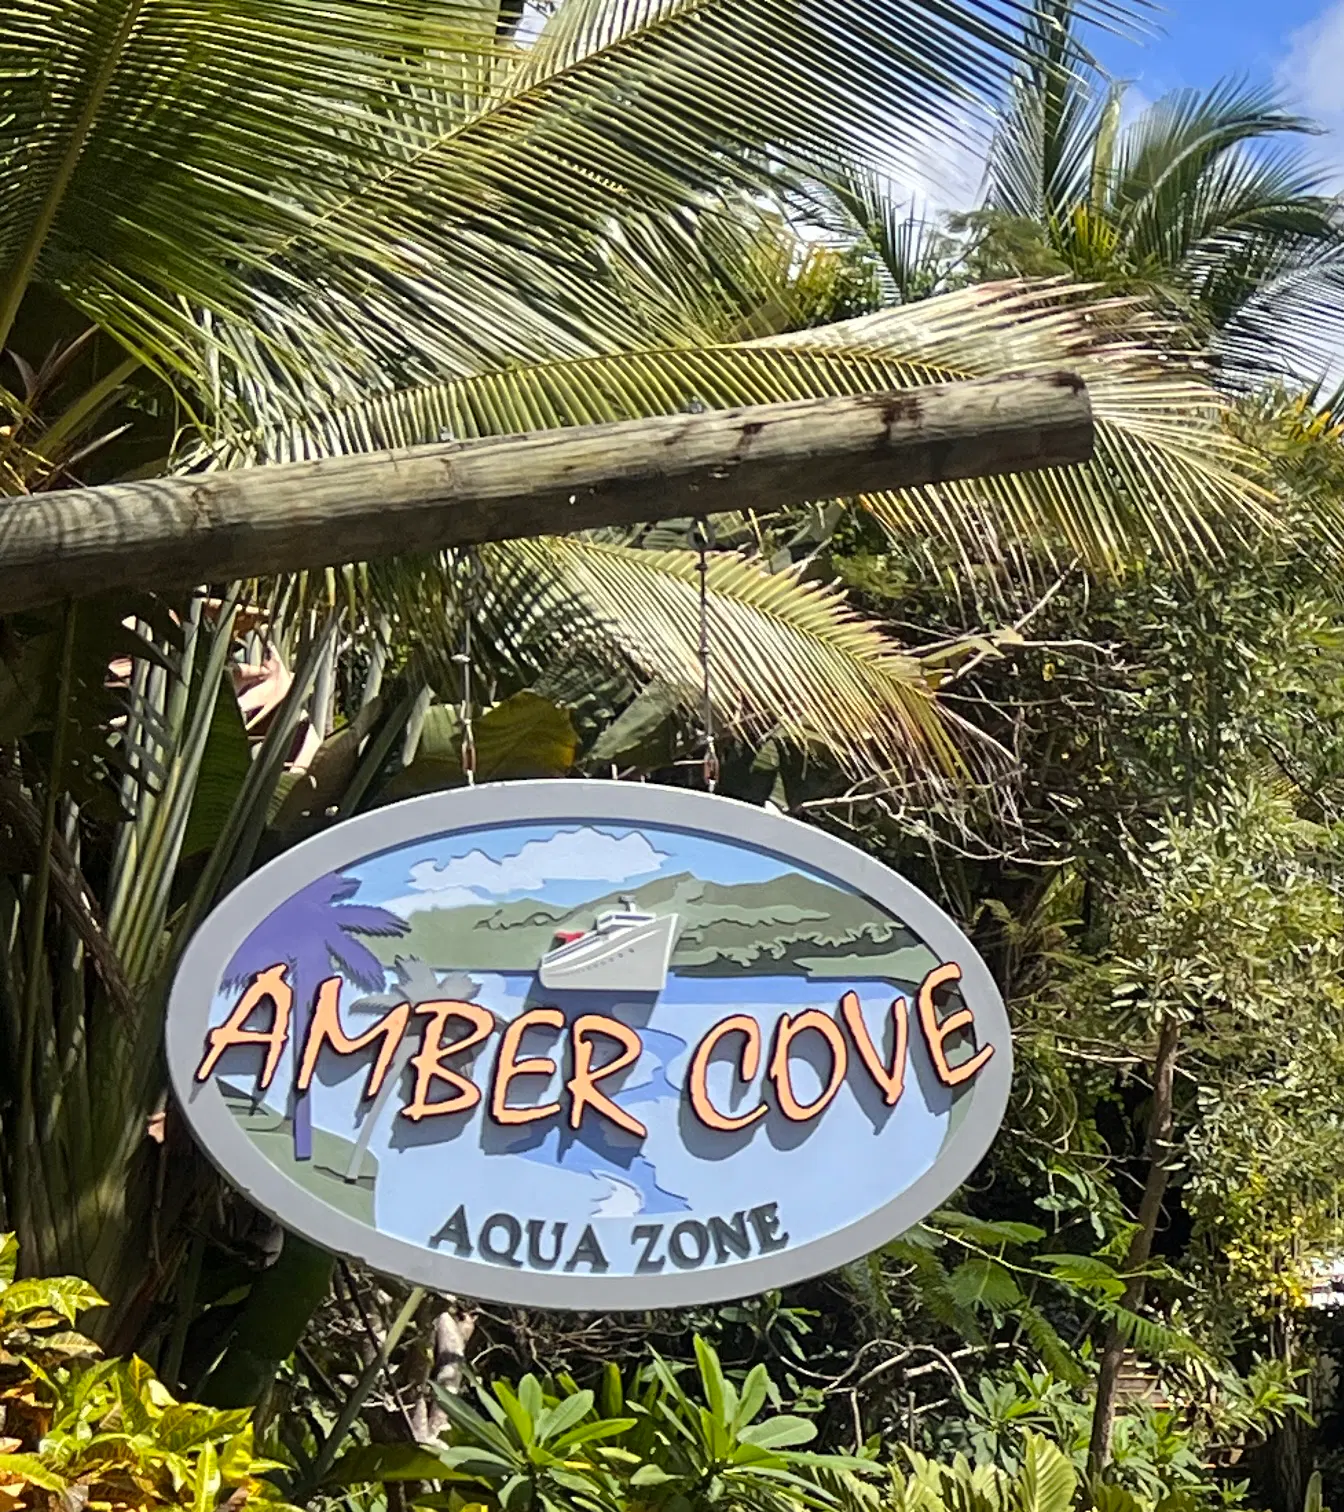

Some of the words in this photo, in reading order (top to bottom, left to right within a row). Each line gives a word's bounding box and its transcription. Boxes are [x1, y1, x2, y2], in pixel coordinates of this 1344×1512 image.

[196, 962, 647, 1139] AMBER
[688, 960, 995, 1133] COVE
[427, 1203, 610, 1274] AQUA
[630, 1200, 790, 1276] ZONE
